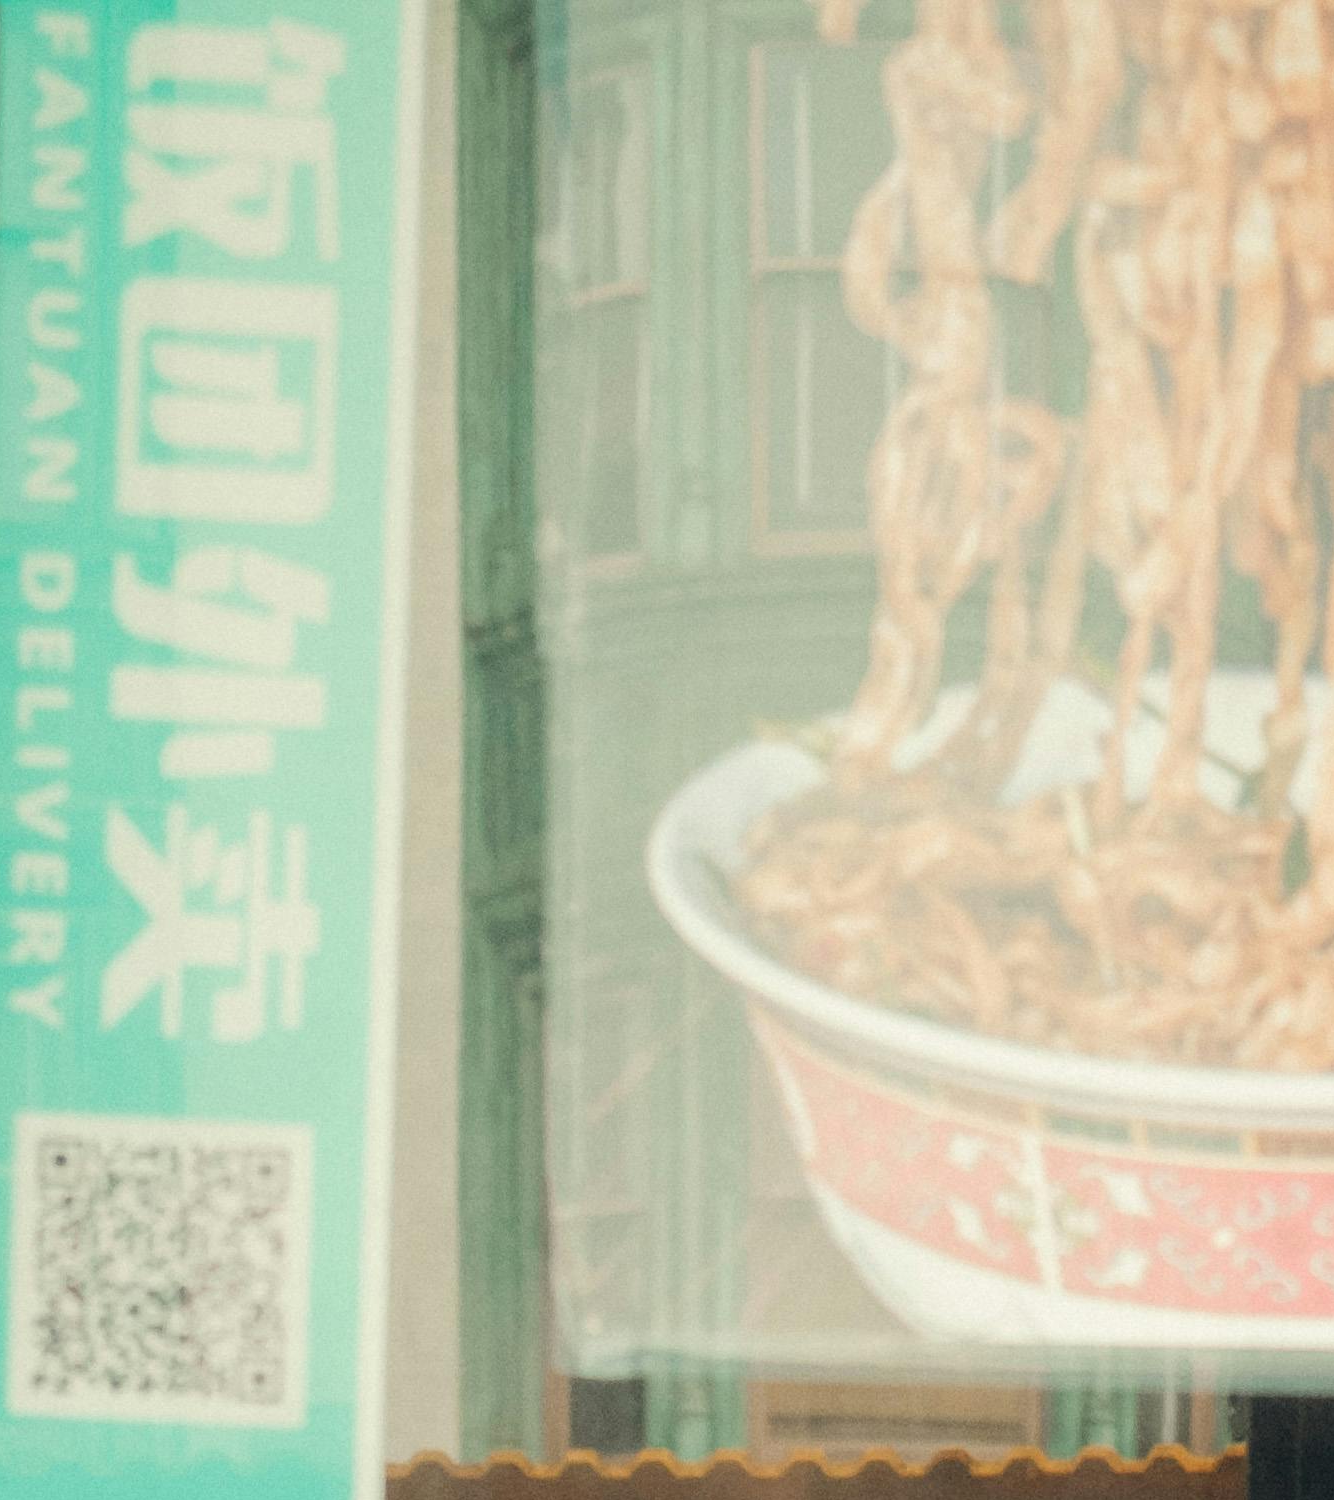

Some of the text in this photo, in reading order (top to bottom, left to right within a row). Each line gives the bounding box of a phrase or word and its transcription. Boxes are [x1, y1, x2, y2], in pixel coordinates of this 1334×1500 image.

[9, 10, 92, 1031] FANTUAN DELIVERY
[100, 16, 348, 1041] 饭团外卖
